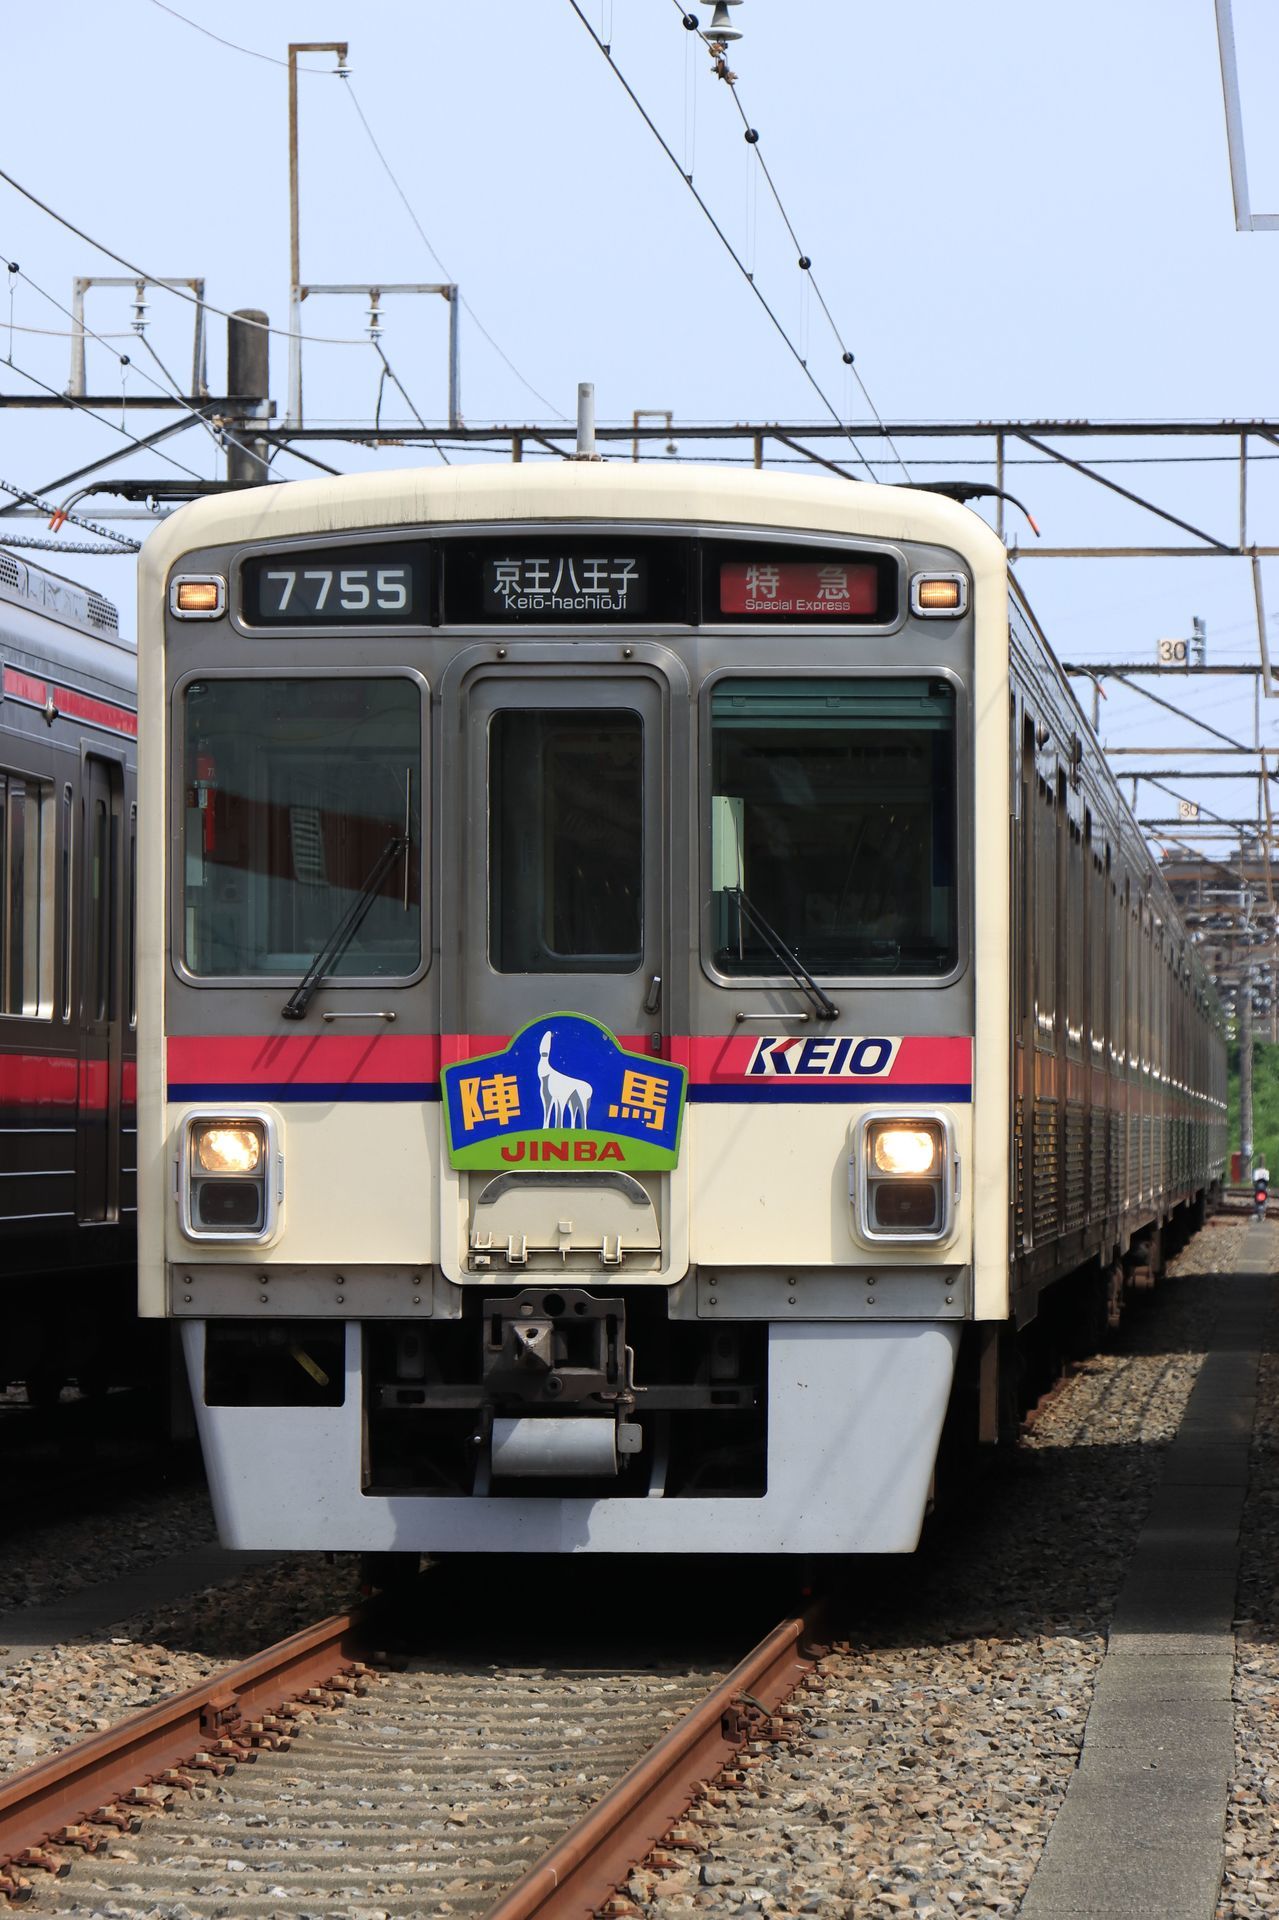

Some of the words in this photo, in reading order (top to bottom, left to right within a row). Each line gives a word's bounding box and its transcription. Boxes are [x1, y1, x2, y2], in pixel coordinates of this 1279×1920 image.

[493, 557, 639, 595] 京王八王子
[267, 570, 407, 611] 7755
[745, 599, 792, 611] Special
[796, 599, 850, 611] Express
[1161, 641, 1187, 661] 30
[1181, 802, 1198, 817] 30
[750, 1038, 893, 1075] KEIO
[501, 1141, 626, 1162] JINBA
